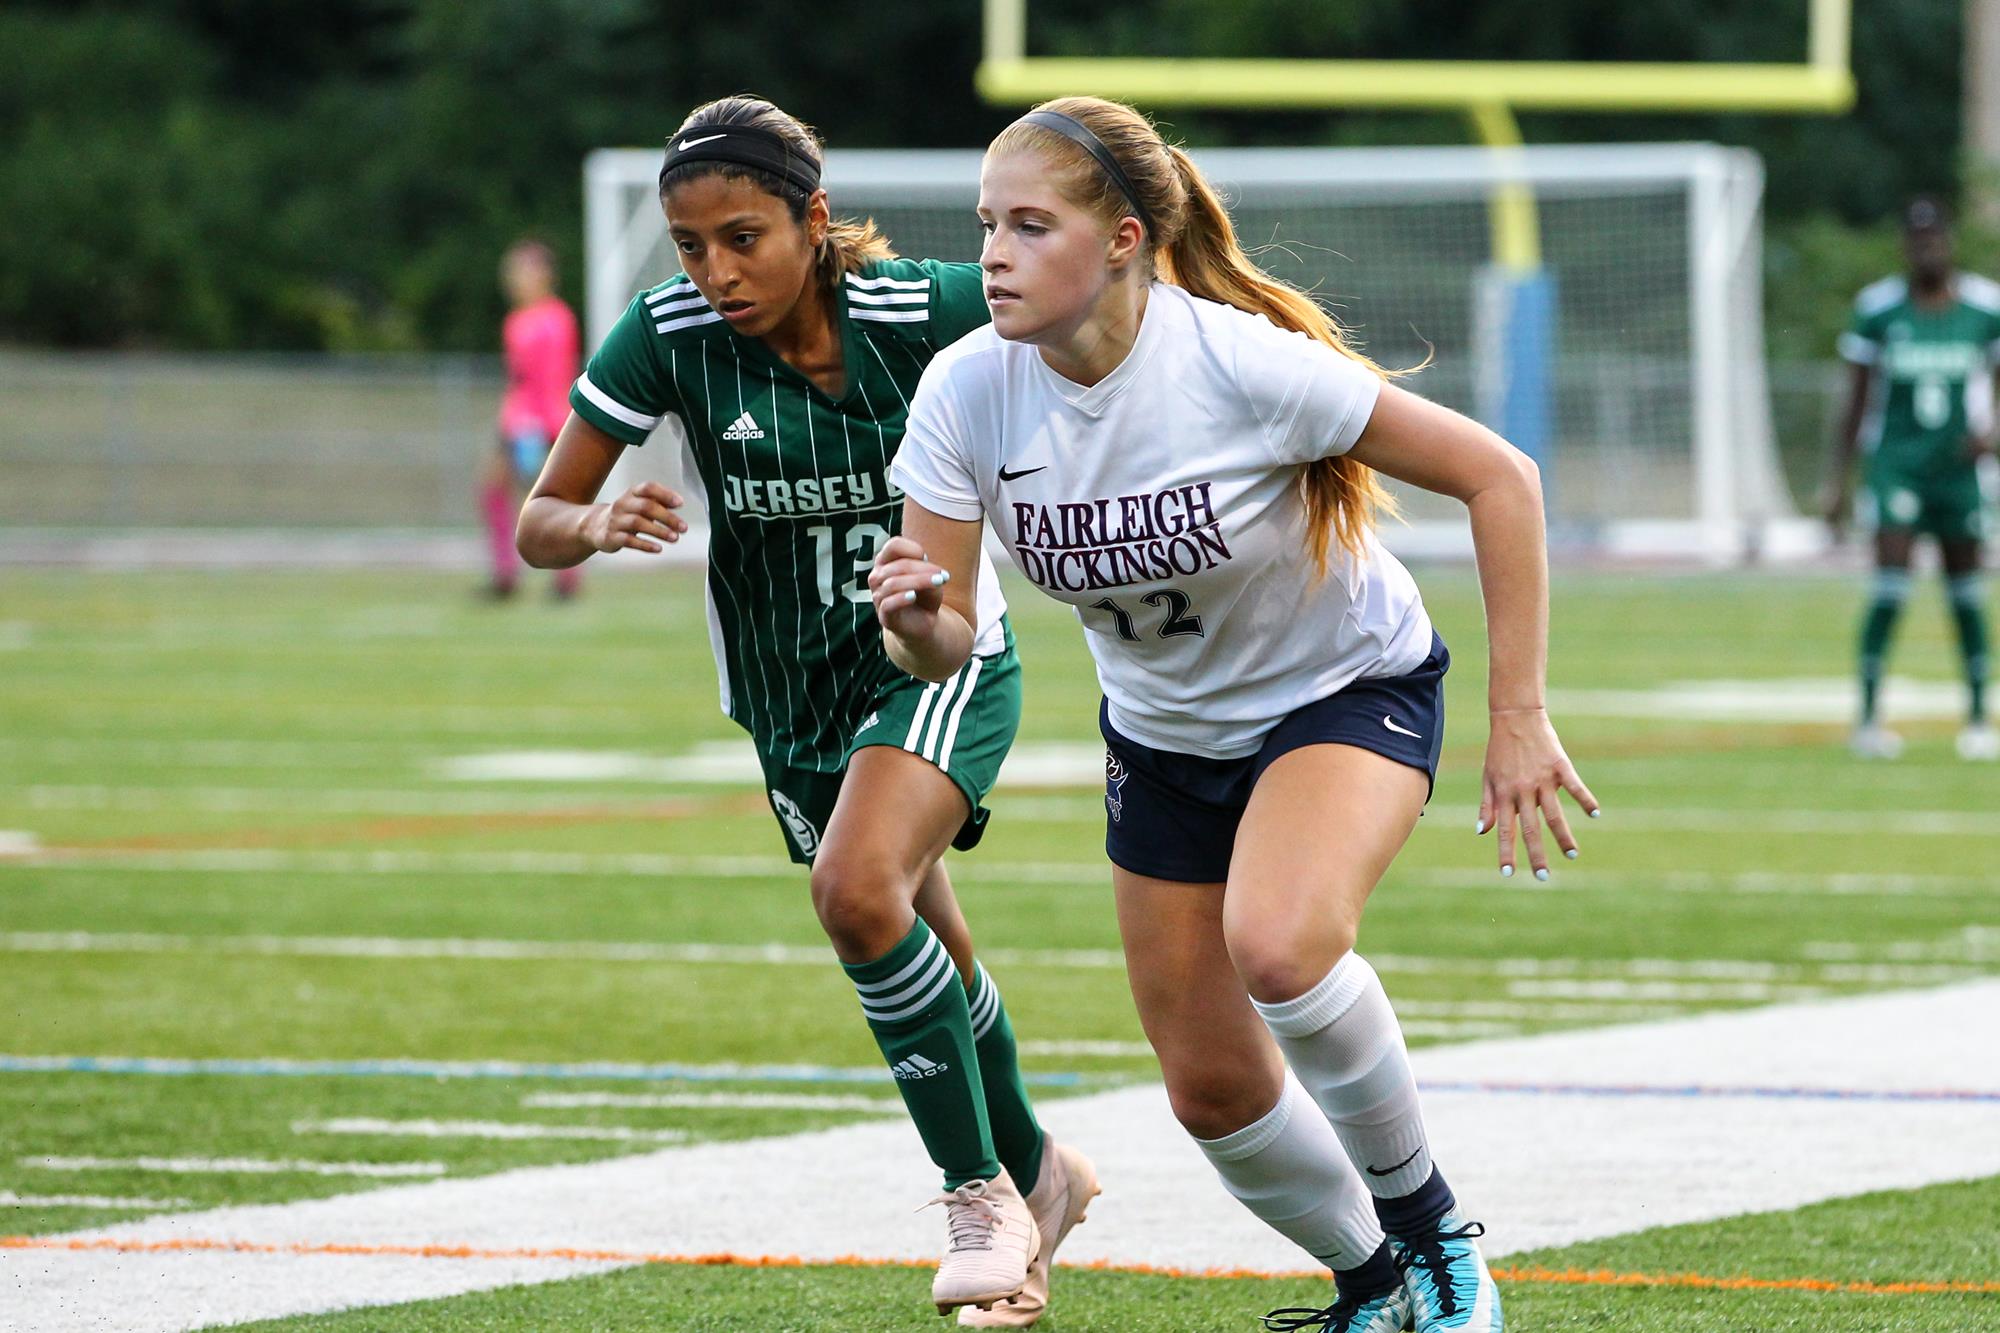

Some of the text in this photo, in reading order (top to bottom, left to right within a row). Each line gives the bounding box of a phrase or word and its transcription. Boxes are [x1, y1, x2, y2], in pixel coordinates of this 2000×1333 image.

[723, 429, 765, 440] adidas
[724, 472, 874, 513] JERSEY
[1012, 482, 1219, 550] FAIRLEIGH
[807, 523, 890, 608] 13
[1016, 522, 1233, 592] DICKINSON
[1089, 588, 1205, 642] 12
[893, 1063, 949, 1080] adidas
